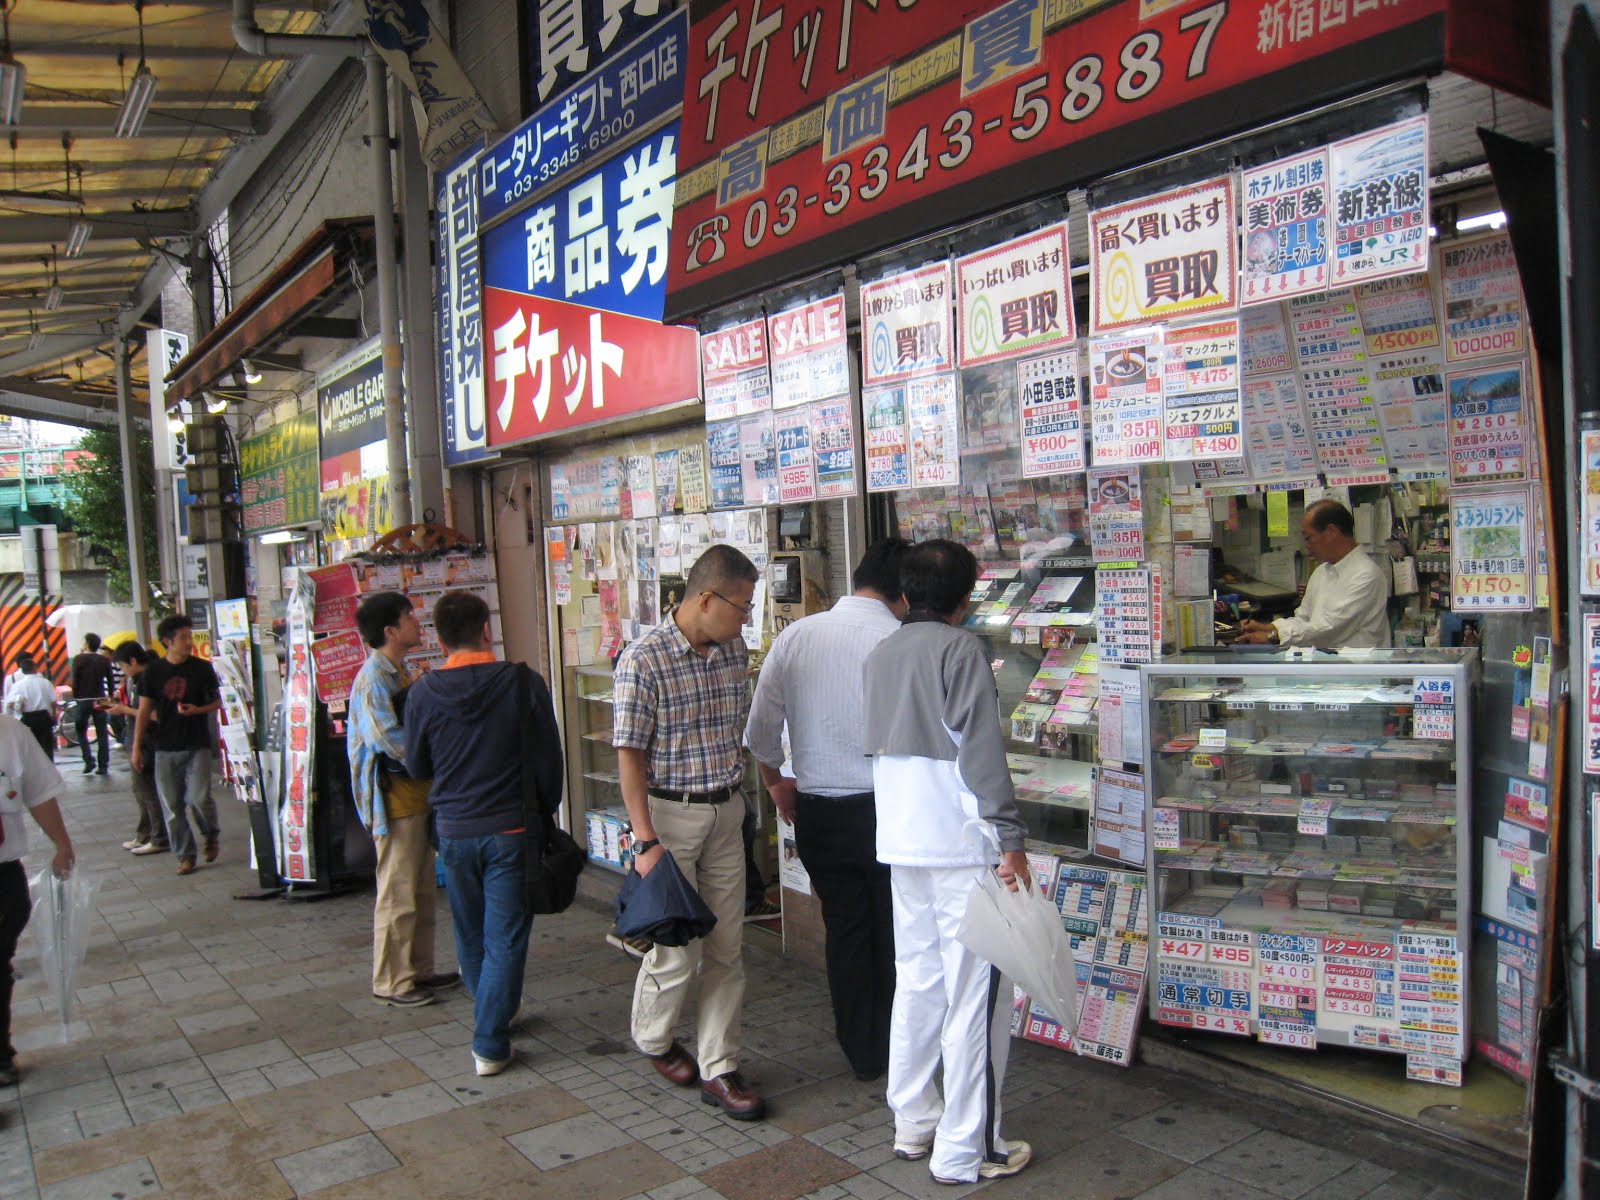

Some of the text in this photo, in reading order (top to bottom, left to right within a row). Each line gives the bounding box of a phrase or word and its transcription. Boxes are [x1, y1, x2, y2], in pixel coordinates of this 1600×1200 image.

[1257, 0, 1399, 53] 新宿西
[482, 75, 613, 197] ロータリーギフト
[618, 35, 678, 108] 西口店
[742, 2, 1230, 248] 03-3343-5887
[1248, 159, 1323, 198] ホテル割引券
[1338, 171, 1422, 225] 新幹線
[524, 135, 677, 297] 商品券
[1249, 187, 1324, 232] 美術券
[1100, 197, 1224, 253] 高く買います
[1338, 211, 1423, 241] 電車回数券
[1400, 227, 1423, 243] KEIO
[1278, 242, 1325, 269] テーマパーク
[1380, 247, 1408, 263] JR
[963, 248, 1063, 294] いっぱい買います
[1145, 249, 1218, 308] 買取
[451, 172, 484, 442] 部屋探し
[866, 281, 946, 317] 1枚から買います
[1000, 289, 1060, 343] 買取
[775, 303, 842, 355] SALE
[1374, 330, 1434, 350] 4500円
[706, 327, 763, 371] SALE
[896, 321, 942, 366] 買取
[1185, 340, 1236, 356] マックカード
[1454, 331, 1516, 355] 10000円
[493, 306, 625, 433] チケット
[1202, 359, 1223, 368] 500円
[331, 380, 364, 420] MOBILE
[1023, 374, 1076, 406] 小田急電鉄
[1094, 396, 1160, 410] プレミアムコーヒー
[1168, 406, 1236, 424] ジェフグルメ
[1123, 420, 1159, 438] 35円
[1168, 426, 1196, 438] SALE
[1206, 422, 1233, 433] 500円
[1454, 430, 1519, 447] 西武園ゆうえんち
[1129, 440, 1160, 457] 100円
[1195, 436, 1238, 453] ¥480
[1455, 448, 1497, 460] のりもの券
[1455, 505, 1524, 527] よみうりランド
[1113, 531, 1140, 543] 35円
[1119, 546, 1142, 558] 100円
[1417, 681, 1451, 692] 入浴券
[1162, 940, 1250, 962] ¥47 ¥95
[1260, 934, 1304, 951] テレホンカード
[1324, 940, 1392, 958] レターパック
[1264, 964, 1310, 979] ¥400
[1328, 976, 1371, 990] ¥485
[1161, 984, 1248, 1008] 通常切手
[1262, 994, 1293, 1007] ¥780
[1328, 1000, 1371, 1014] ¥340
[1030, 1020, 1071, 1043] 回数券
[1263, 1030, 1308, 1045] ¥900
[1096, 1045, 1123, 1060] 販売中
